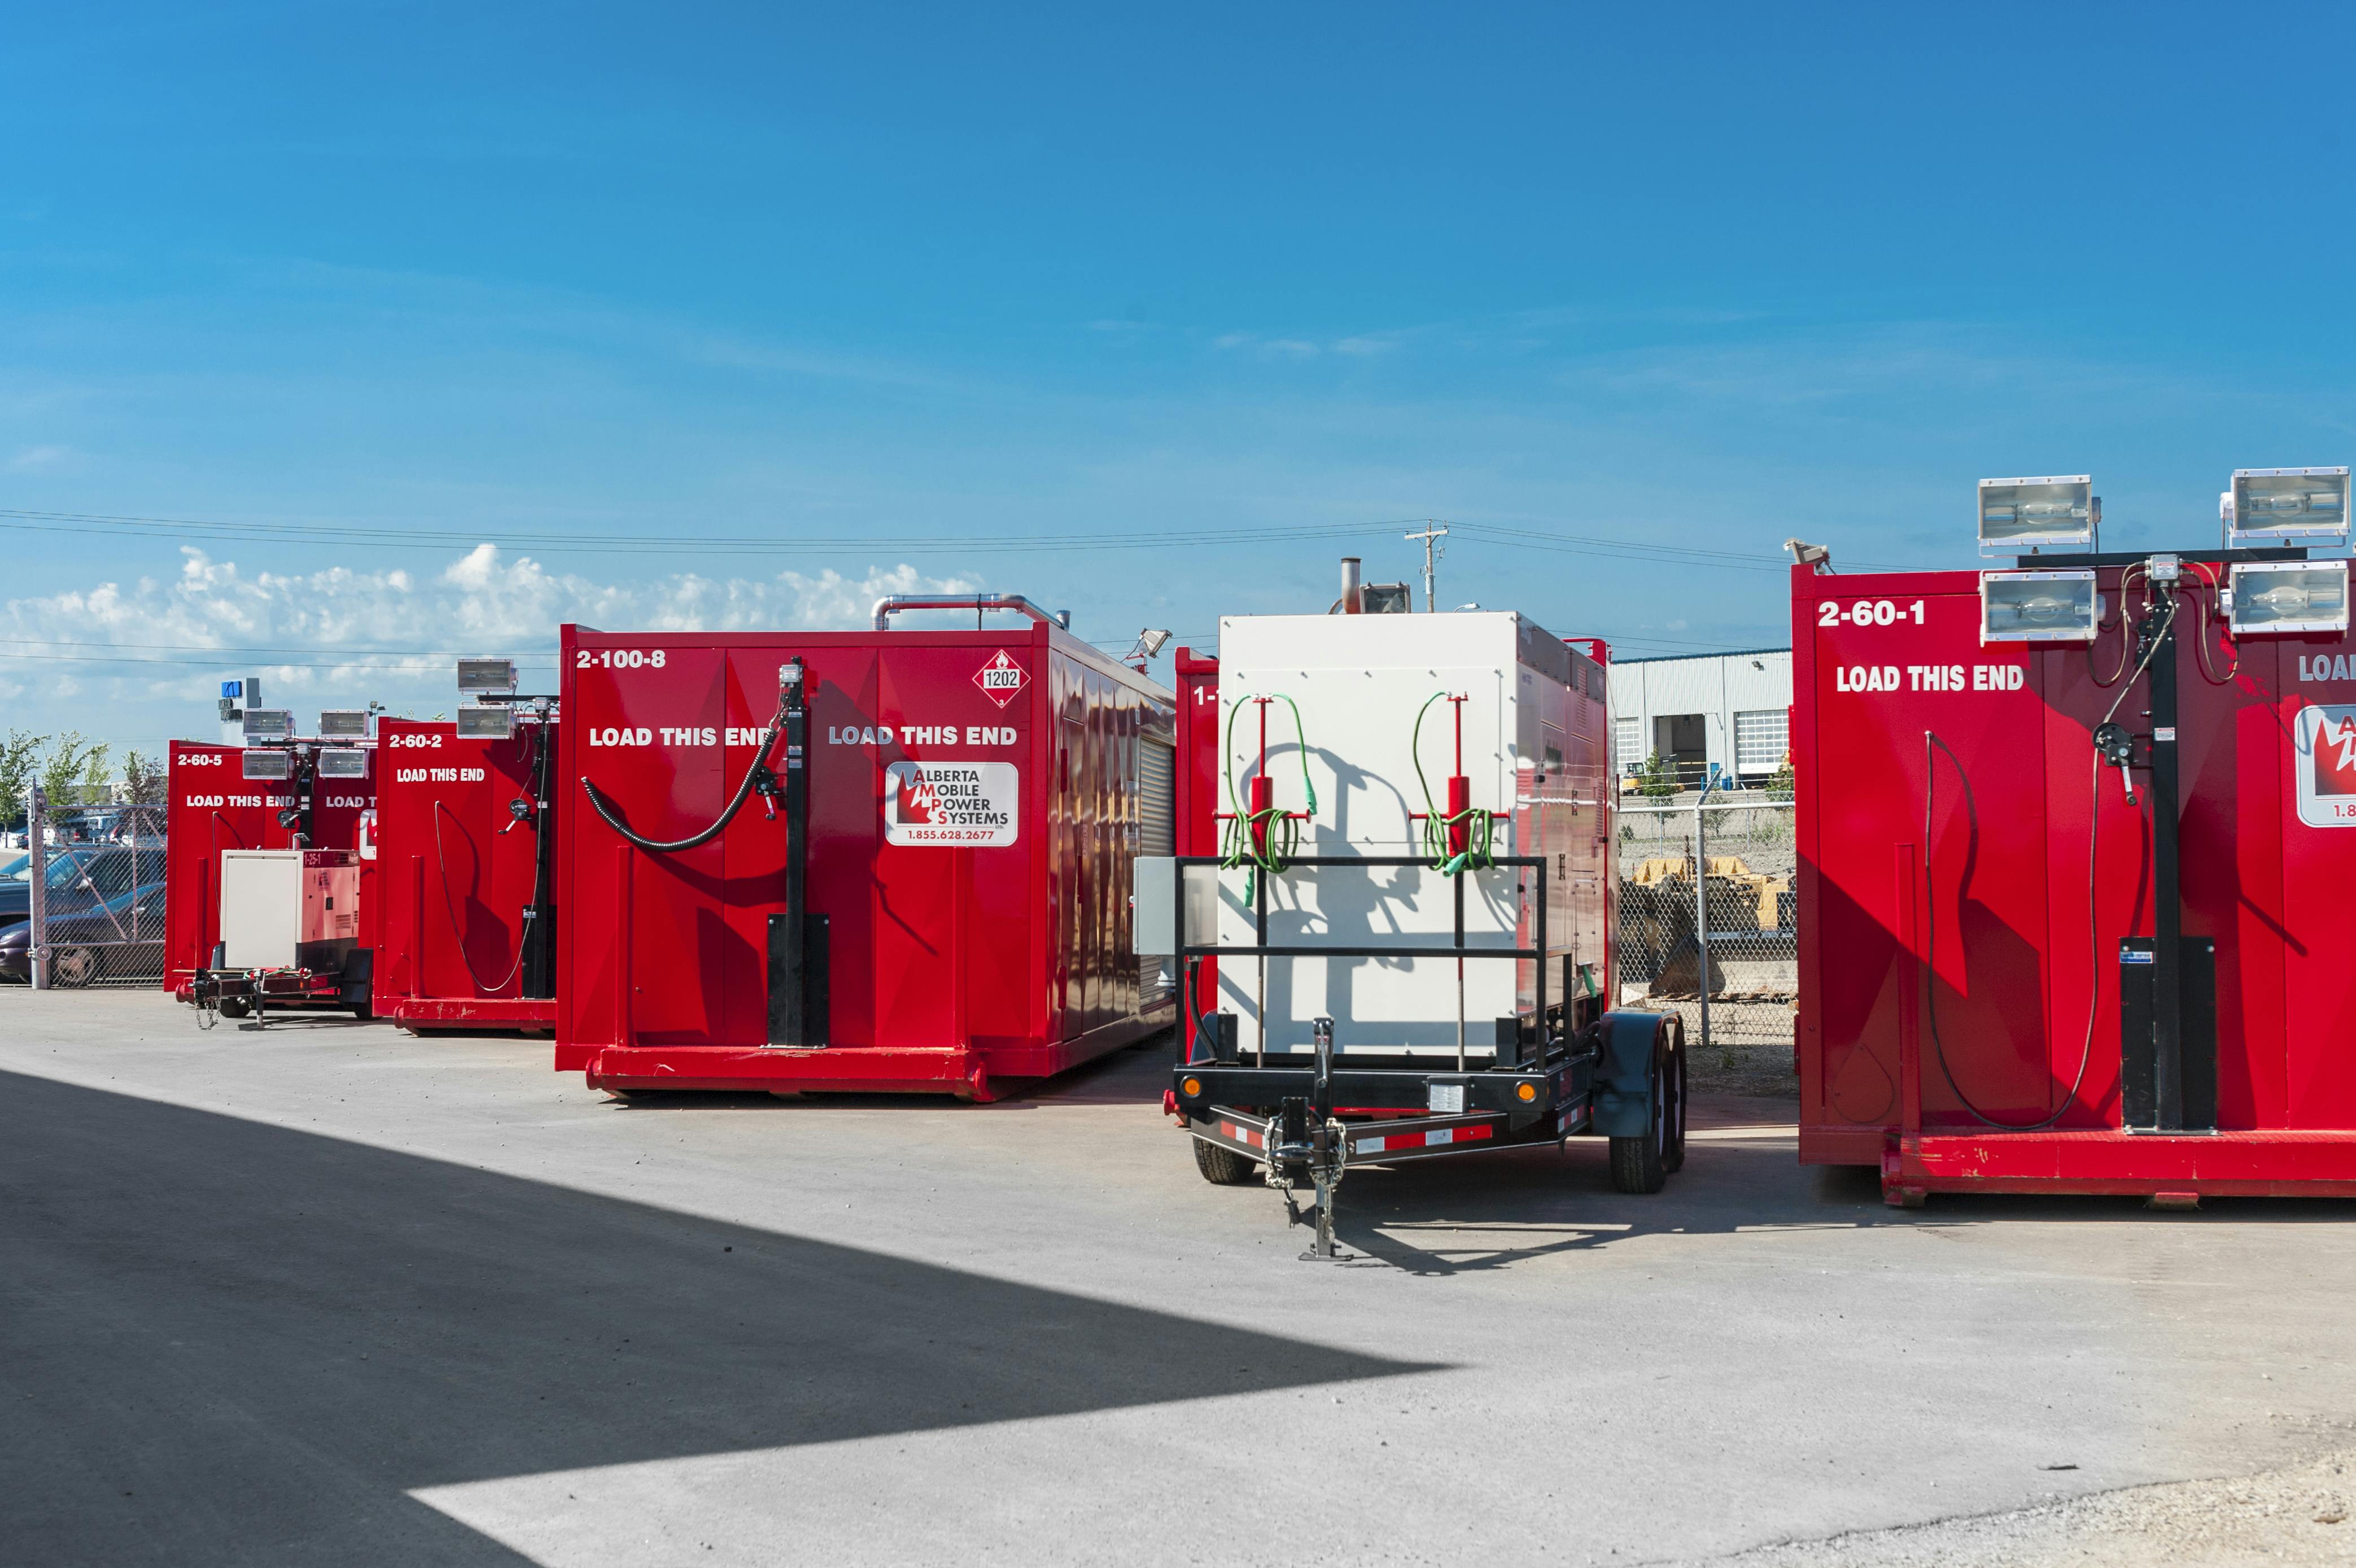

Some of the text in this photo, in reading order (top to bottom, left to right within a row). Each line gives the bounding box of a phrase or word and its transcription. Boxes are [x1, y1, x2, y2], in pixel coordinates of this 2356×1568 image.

[1818, 600, 1925, 627] 2-60-1
[576, 649, 666, 669] 2-100-8
[986, 671, 1017, 686] 1202
[1837, 665, 2024, 692] LOAD THIS END
[389, 734, 442, 748] 2-60-2
[589, 727, 653, 746] LOAD
[659, 727, 717, 746] THIS
[829, 726, 1017, 745] LOAD THIS END
[178, 754, 222, 766] 2-60-5
[397, 768, 485, 783] LOAD THIS END
[912, 770, 980, 783] ALBERTA
[919, 784, 980, 798] MOBILE
[186, 795, 224, 807] LOAD
[228, 795, 261, 807] THIS
[266, 796, 295, 807] END
[326, 796, 364, 807] LOAD
[932, 798, 991, 812] POWER
[938, 811, 1008, 825] SYSTEMS
[908, 830, 994, 840] 1.855.628.2677
[304, 853, 321, 866] 1-25-1
